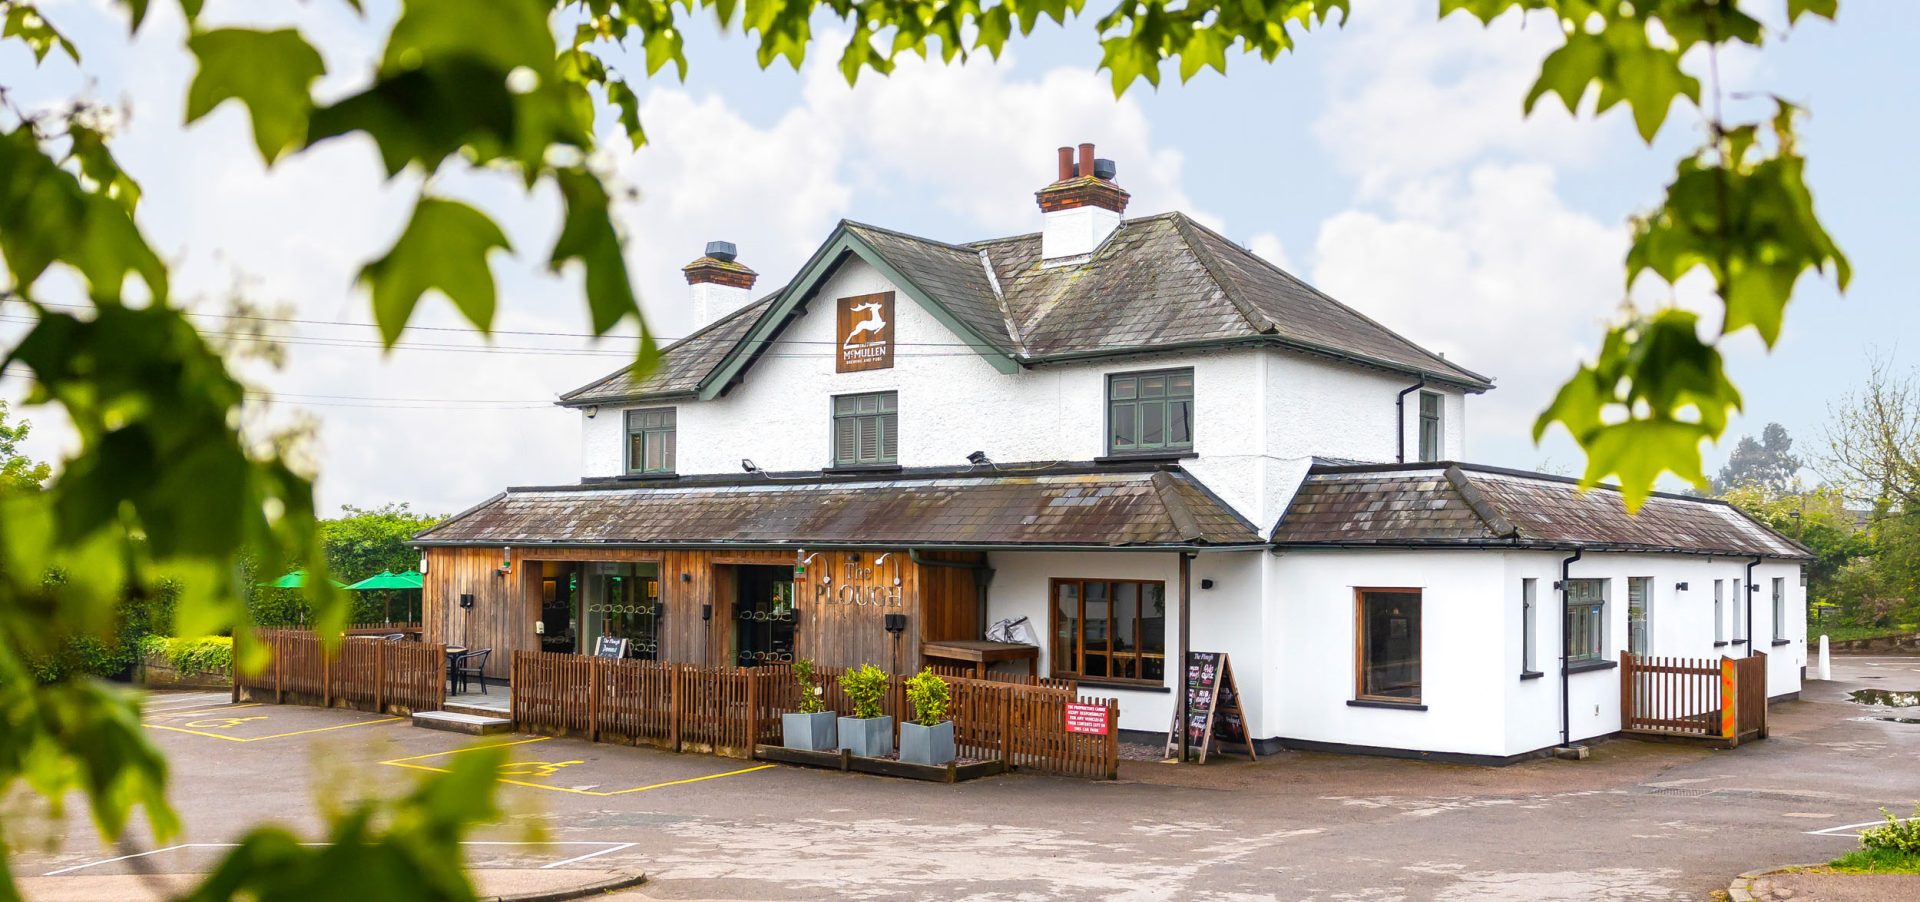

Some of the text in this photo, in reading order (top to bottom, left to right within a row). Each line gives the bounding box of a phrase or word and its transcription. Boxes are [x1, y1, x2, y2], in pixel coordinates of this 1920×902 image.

[844, 346, 886, 360] McMULLEN
[844, 561, 871, 580] The
[815, 583, 902, 607] PLOUGH
